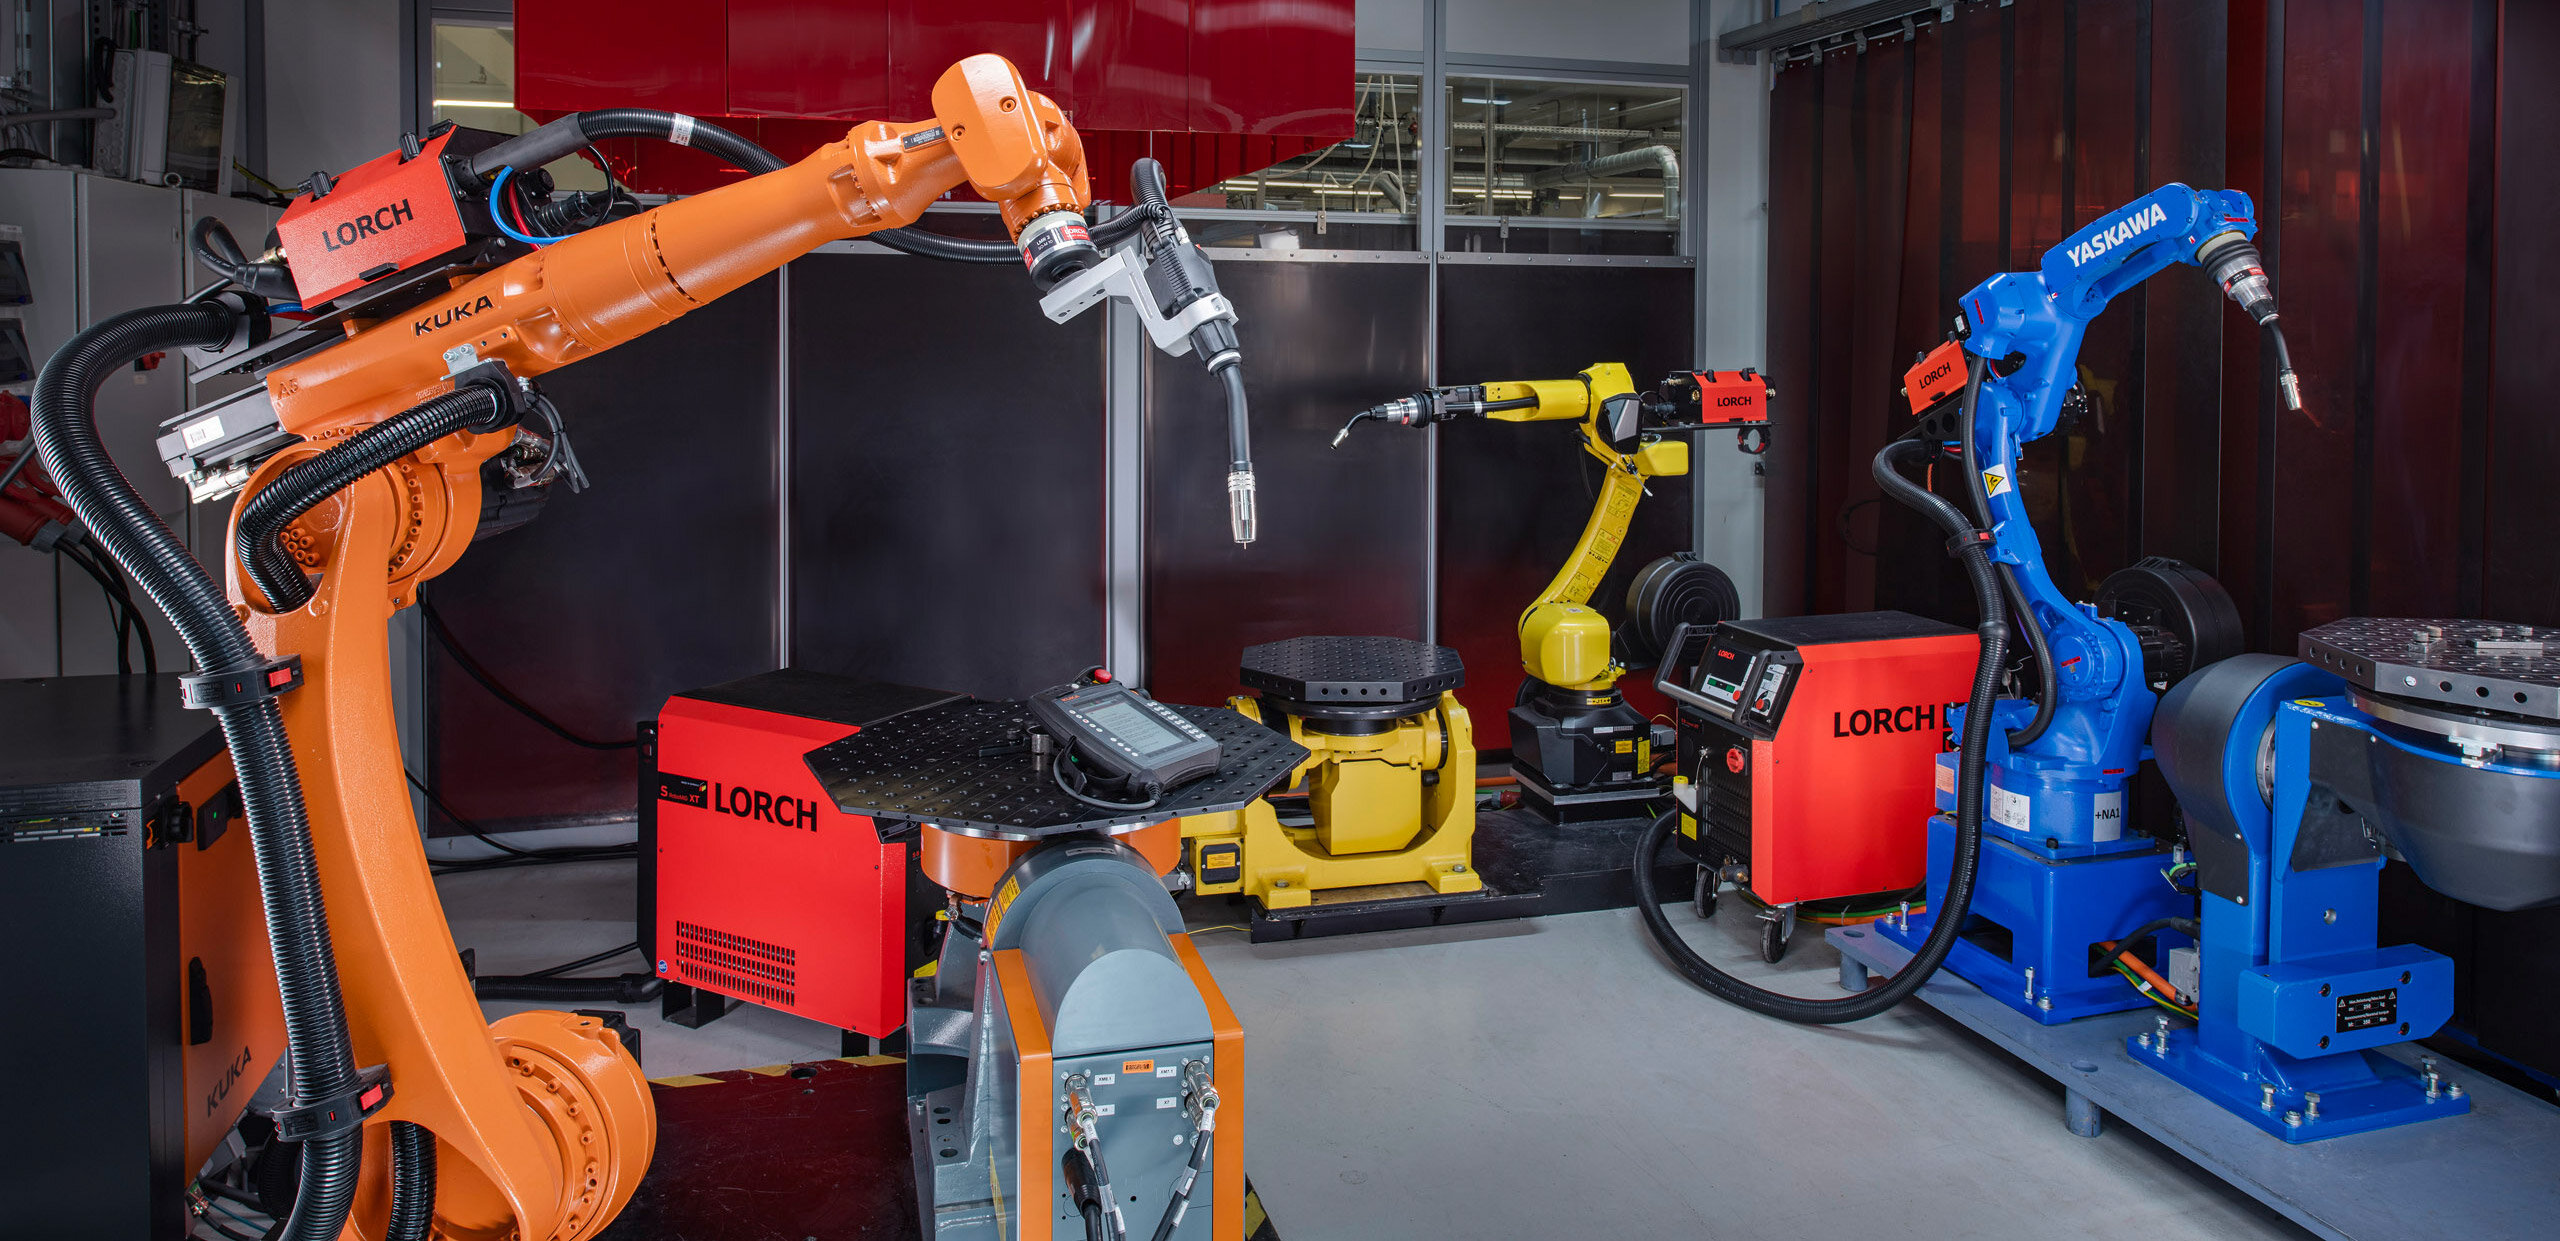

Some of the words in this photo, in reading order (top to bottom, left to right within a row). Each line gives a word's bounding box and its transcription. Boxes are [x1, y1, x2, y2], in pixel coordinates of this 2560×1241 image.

[322, 198, 414, 253] LORCH
[2066, 203, 2167, 268] YASKAWA
[415, 295, 494, 337] KUKA
[1918, 361, 1951, 389] LORCH
[1717, 396, 1752, 407] LORCH
[1717, 649, 1735, 660] LORCH
[1834, 704, 1935, 738] LORCH
[689, 794, 700, 803] XT
[715, 782, 817, 832] LORCH
[2095, 807, 2120, 820] +NA1
[206, 1046, 251, 1118] KUKA
